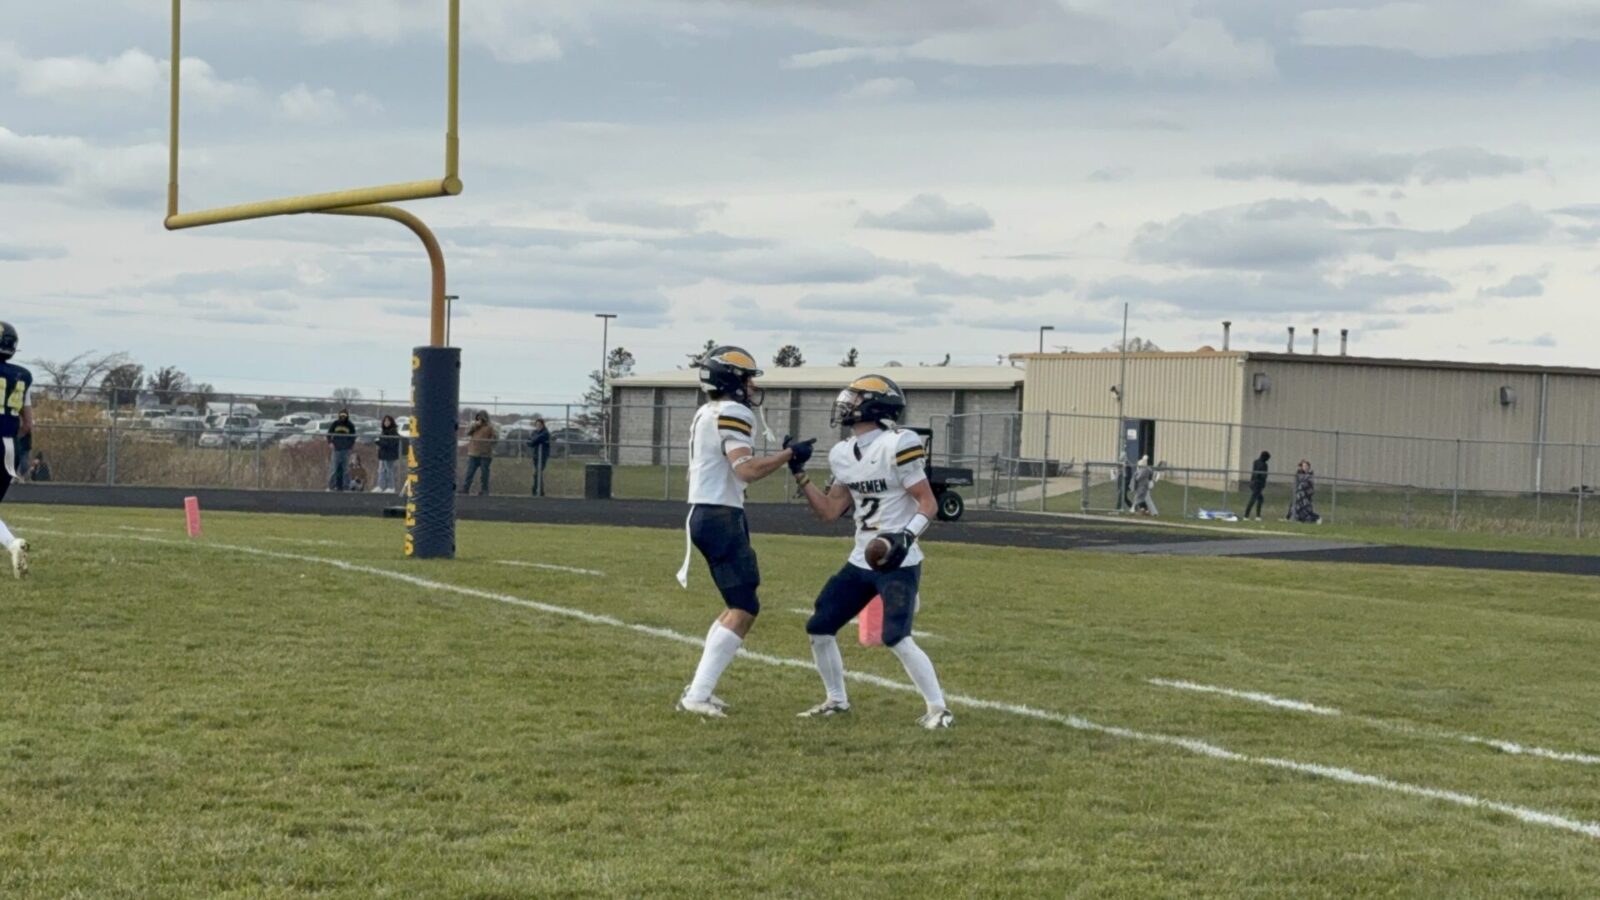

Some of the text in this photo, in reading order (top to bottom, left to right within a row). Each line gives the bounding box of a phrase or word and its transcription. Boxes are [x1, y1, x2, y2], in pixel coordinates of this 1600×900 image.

[404, 355, 420, 556] PIRATES
[847, 478, 888, 494] SEMEN
[860, 497, 880, 531] 2
